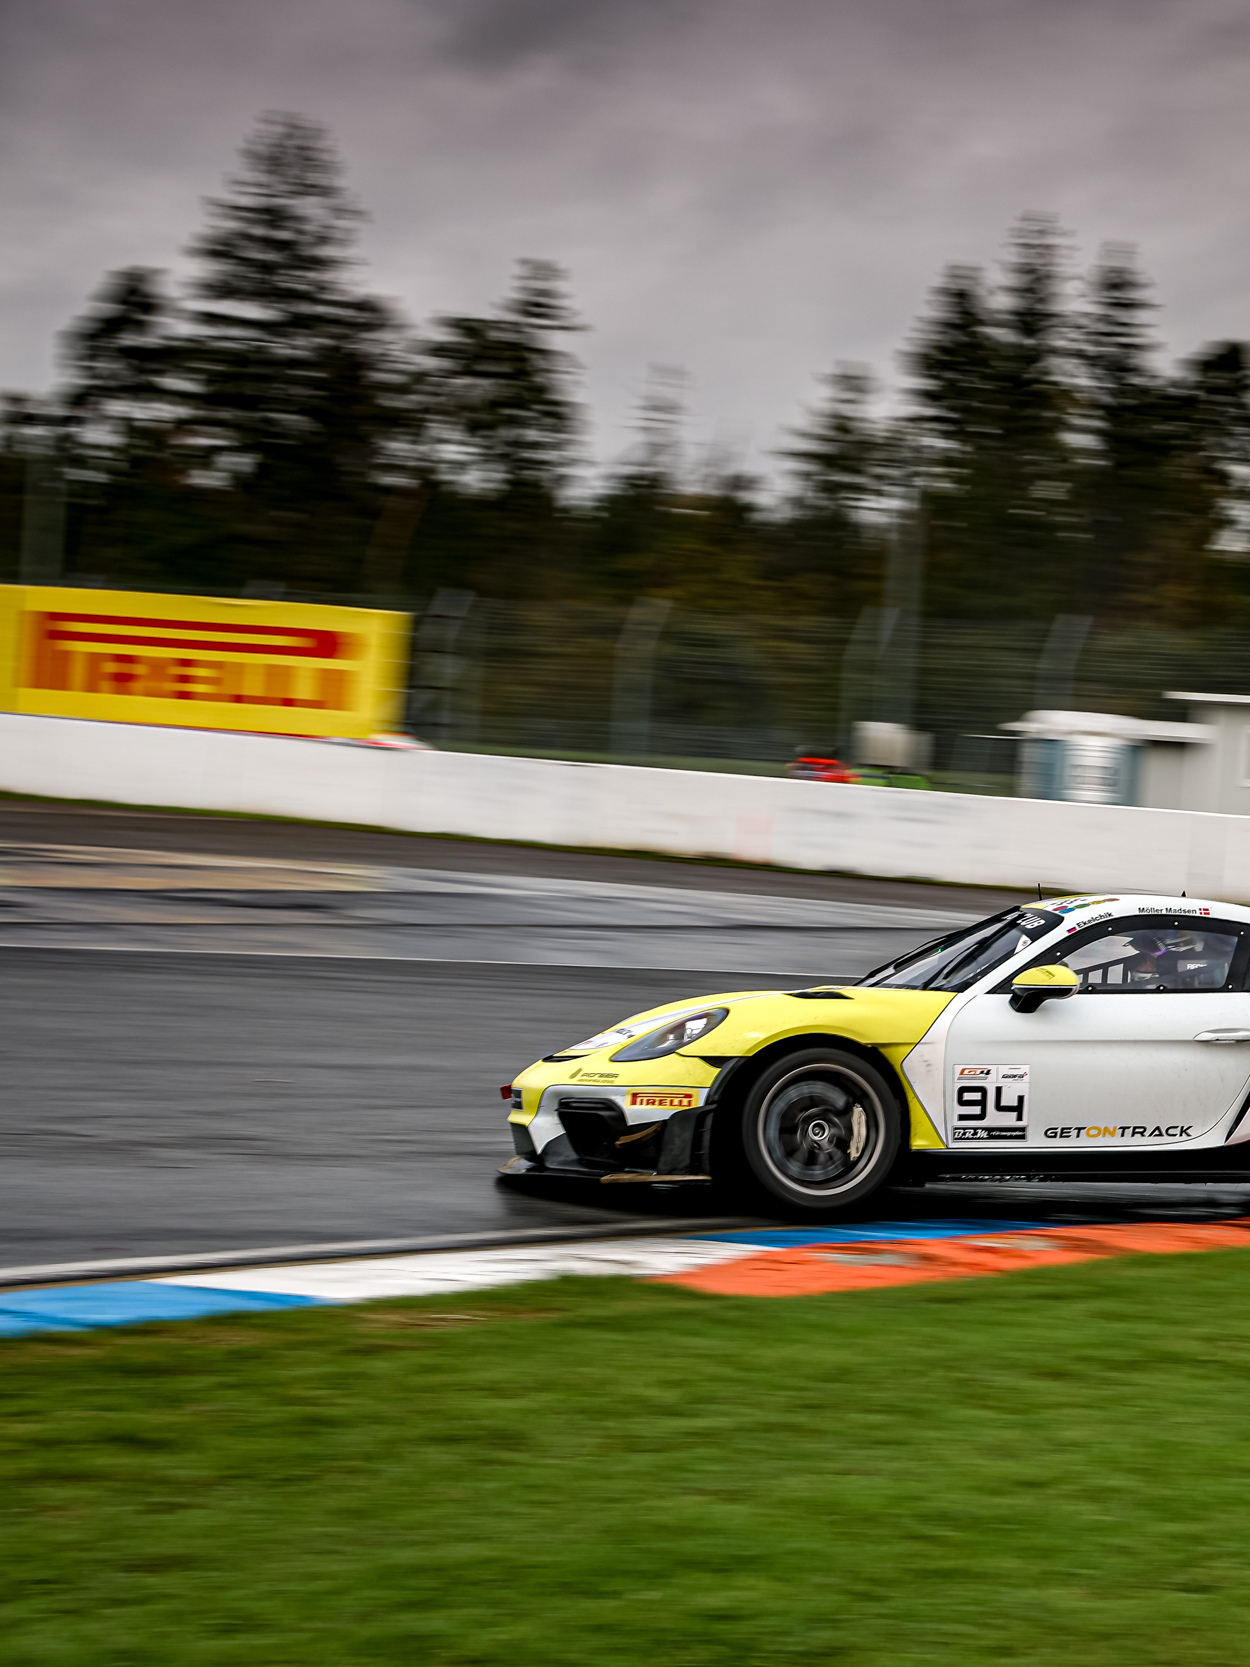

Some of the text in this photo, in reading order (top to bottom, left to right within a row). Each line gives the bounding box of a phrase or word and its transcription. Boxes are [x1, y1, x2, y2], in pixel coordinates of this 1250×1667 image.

[22, 610, 362, 711] PIRELLI
[630, 1092, 693, 1108] PIRELLI
[957, 1085, 1025, 1122] 94
[1043, 1125, 1194, 1139] GETONTRACK
